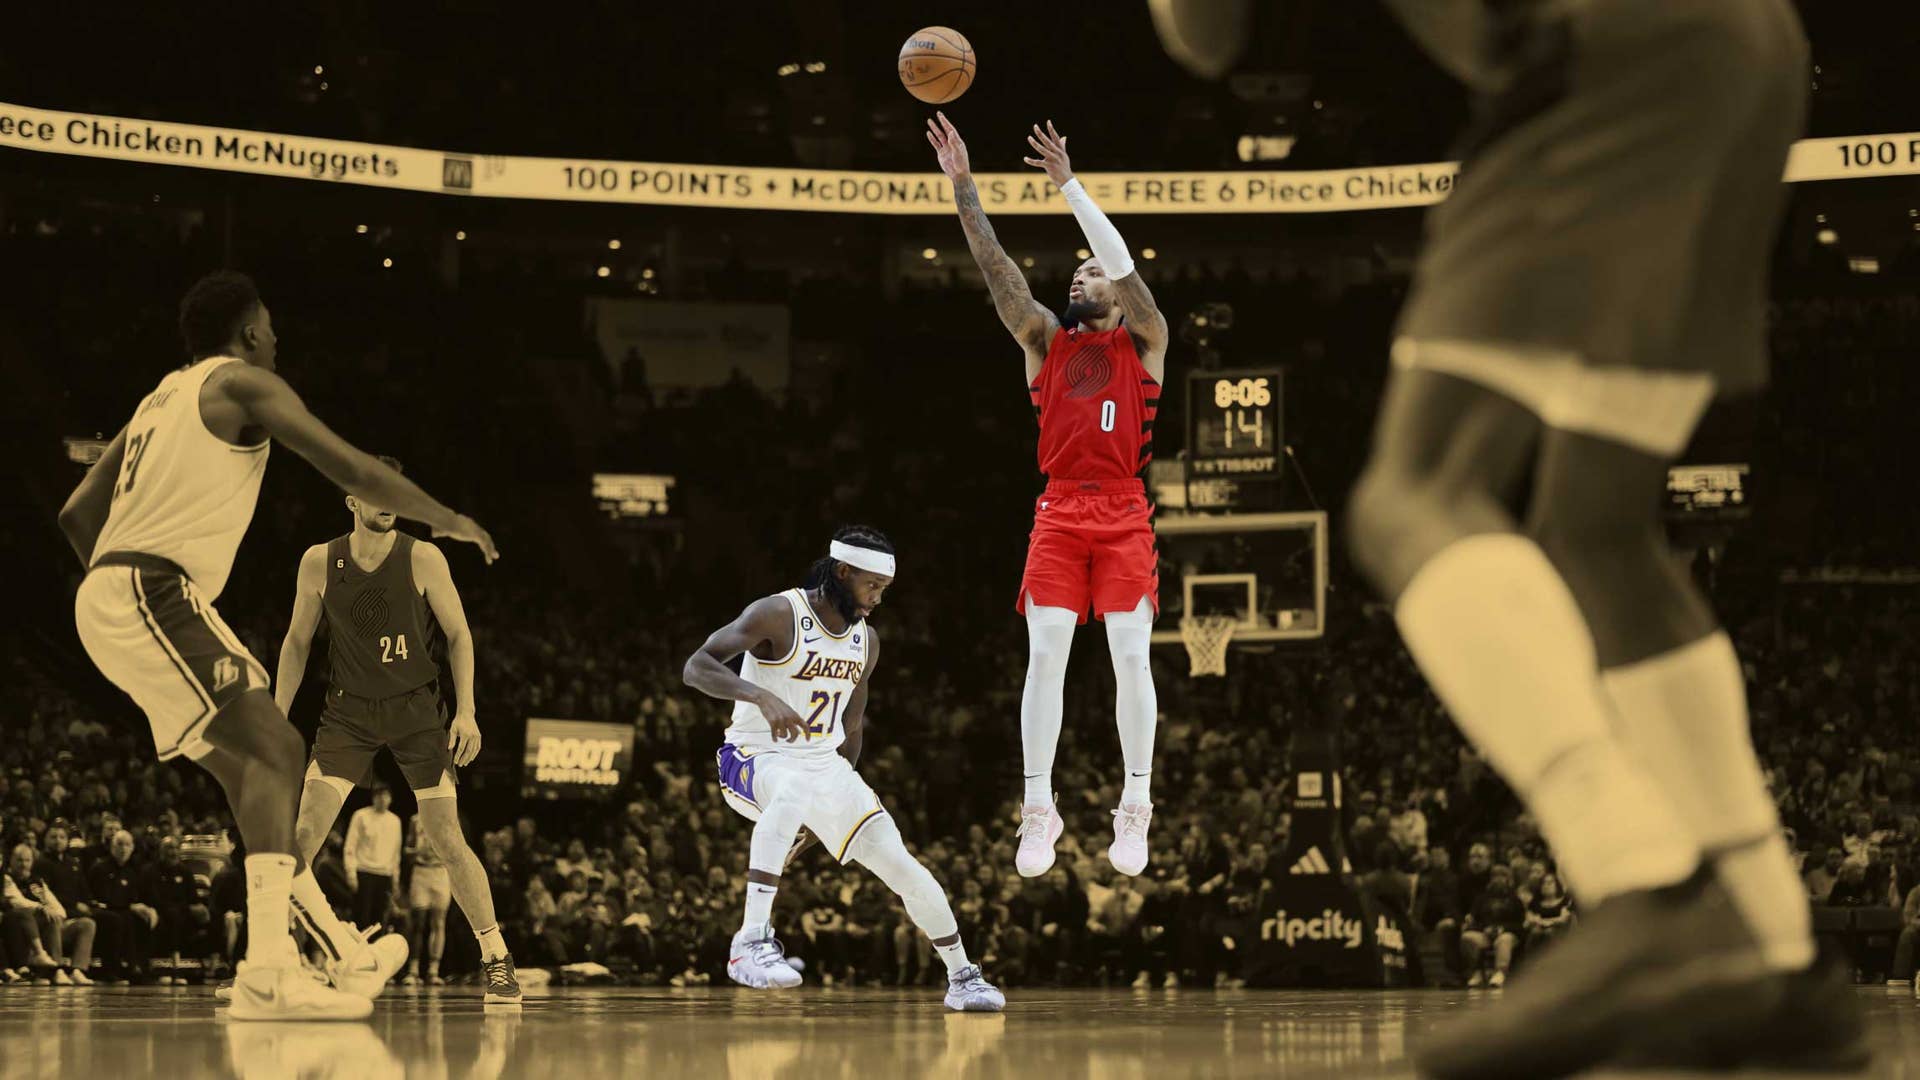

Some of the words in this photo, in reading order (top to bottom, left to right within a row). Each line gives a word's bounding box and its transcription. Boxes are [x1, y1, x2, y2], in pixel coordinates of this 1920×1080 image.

[66, 119, 202, 157] Chicken
[214, 135, 400, 179] McNuggets
[562, 167, 618, 191] 100
[630, 170, 752, 197] POINTS
[791, 177, 1007, 205] McDONAL'S
[1020, 181, 1085, 203] AP
[1124, 179, 1204, 203] FREE
[1218, 178, 1236, 202] 6
[1248, 177, 1334, 203] Piece
[1838, 141, 1897, 167] 100
[1215, 378, 1271, 408] 8:06
[1101, 400, 1116, 432] 0
[1225, 409, 1263, 448] 14
[336, 558, 345, 569] 6
[801, 617, 812, 630] 6
[379, 634, 409, 663] 24
[791, 650, 863, 685] LAKERS
[803, 690, 843, 737] 21
[536, 737, 622, 770] ROOT
[1262, 909, 1362, 948] ripcity
